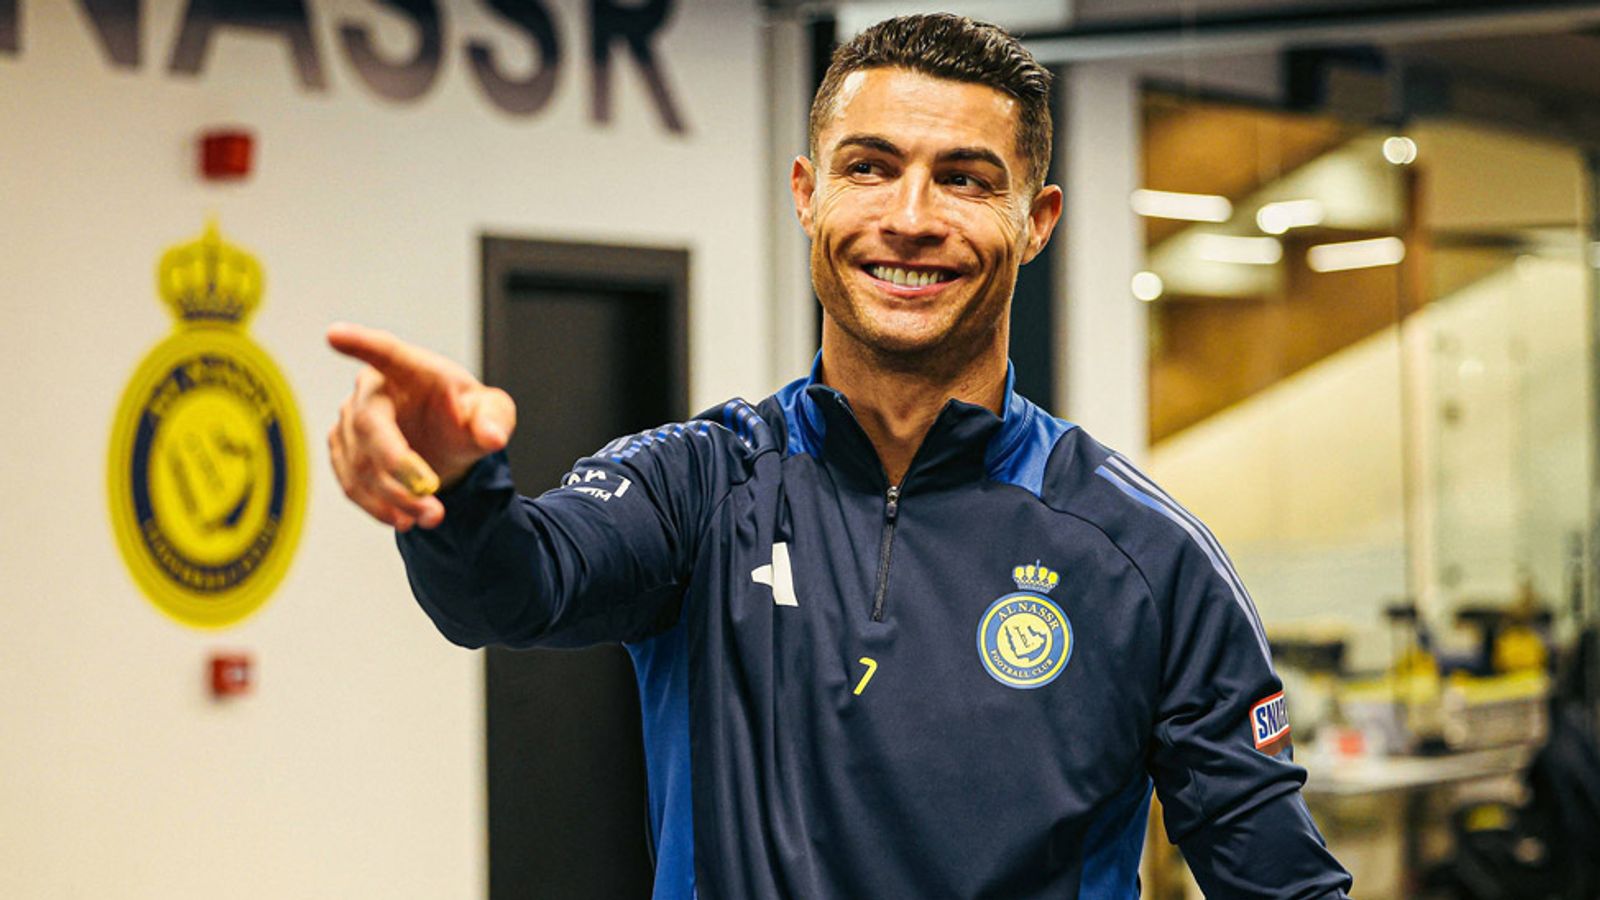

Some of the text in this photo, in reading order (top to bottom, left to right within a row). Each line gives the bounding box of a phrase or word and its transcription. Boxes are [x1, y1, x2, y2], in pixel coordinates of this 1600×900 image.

[0, 0, 688, 135] SSR
[999, 602, 1059, 630] AL NASSR
[853, 657, 878, 695] 7
[991, 649, 1030, 677] FOOTBALL
